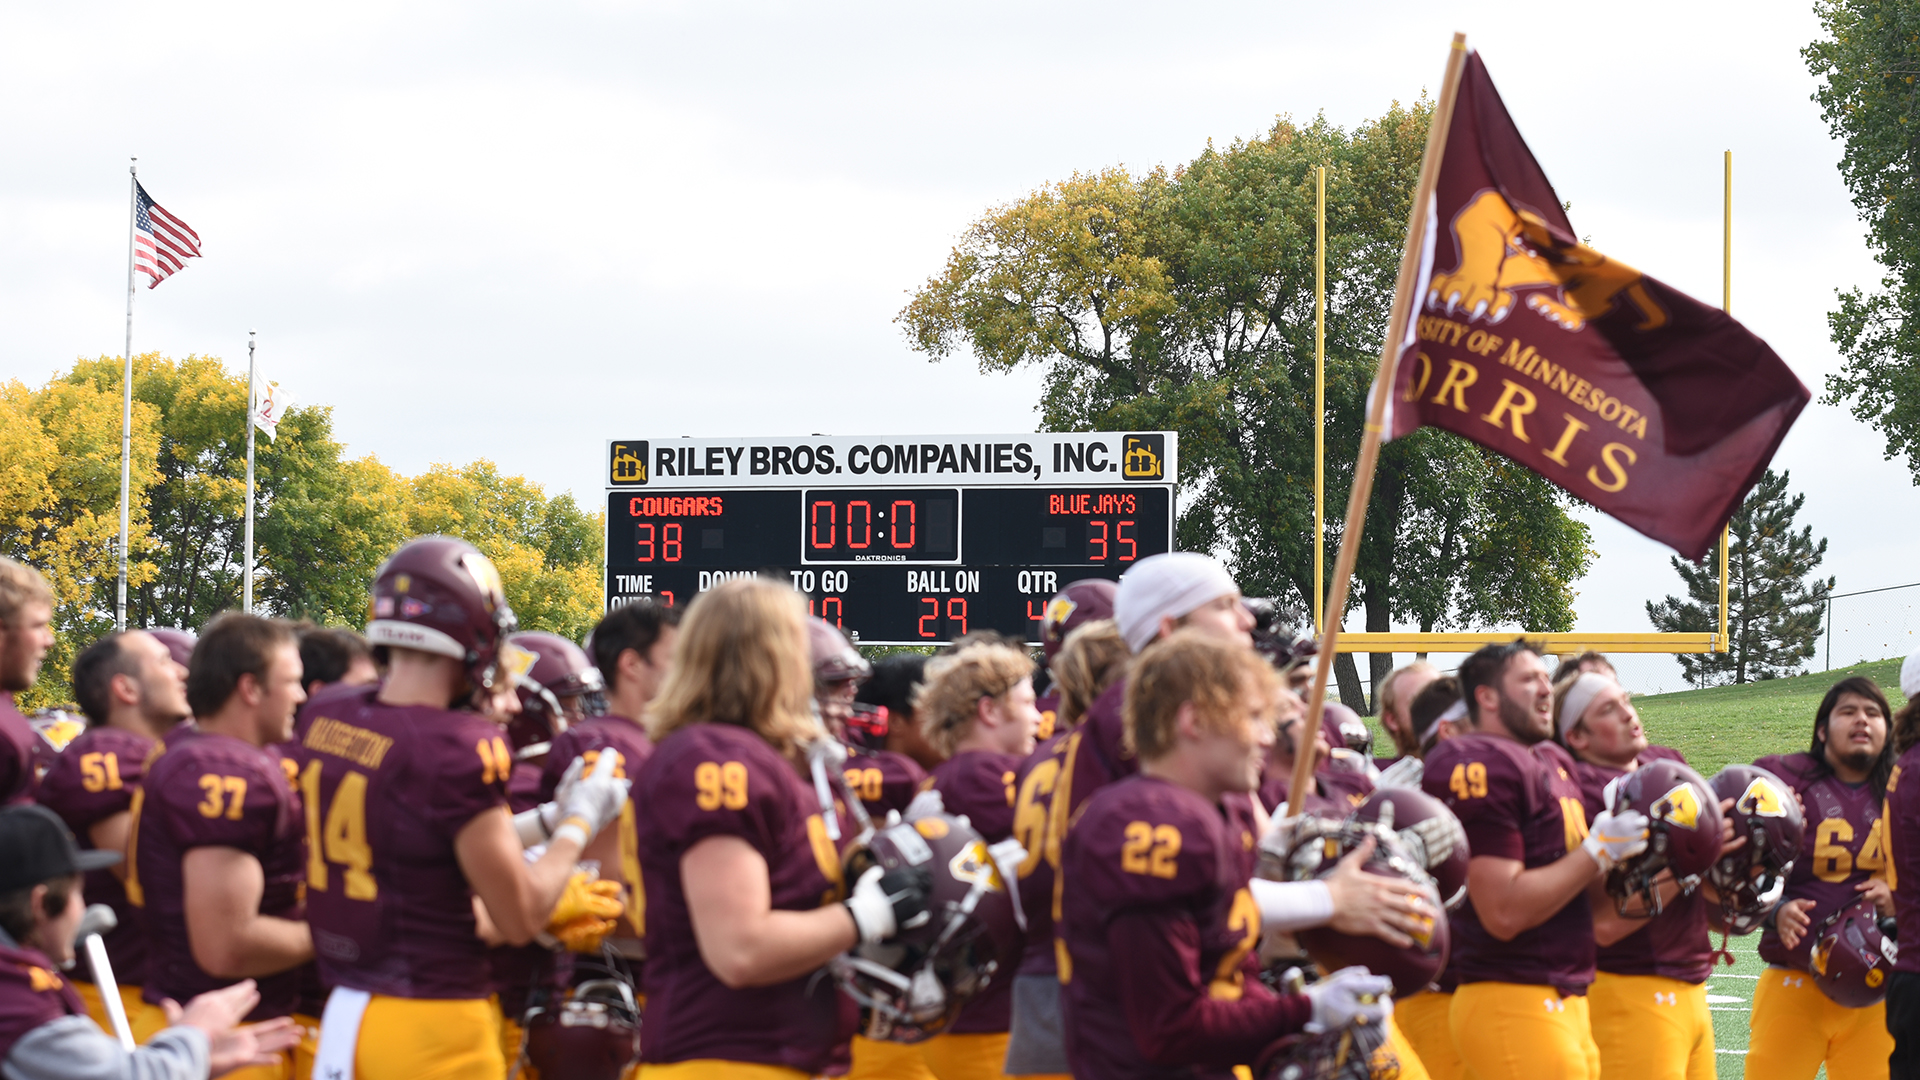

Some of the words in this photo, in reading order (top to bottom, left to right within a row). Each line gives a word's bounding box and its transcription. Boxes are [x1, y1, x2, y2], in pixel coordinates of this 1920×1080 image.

[1466, 329, 1504, 357] OF
[1499, 338, 1649, 440] MINNESOTA
[656, 447, 744, 476] RILEY
[750, 445, 842, 476] BROS.
[848, 442, 1041, 481] COMPANIES,
[1053, 442, 1117, 473] INC.
[629, 497, 723, 517] COUGARS
[637, 523, 682, 562] 38
[1089, 521, 1137, 561] 35
[615, 575, 653, 593] TIME
[790, 570, 815, 593] TO
[821, 570, 848, 593] GO
[907, 570, 951, 593] BALL
[955, 570, 980, 593] ON
[1018, 570, 1058, 594] QTR
[918, 597, 967, 637] 29
[80, 752, 123, 792] 51
[695, 760, 748, 811] 99
[1449, 762, 1488, 800] 49
[198, 774, 247, 820] 37
[301, 758, 378, 902] 14
[1121, 820, 1182, 880] 22
[1812, 817, 1885, 883] 64
